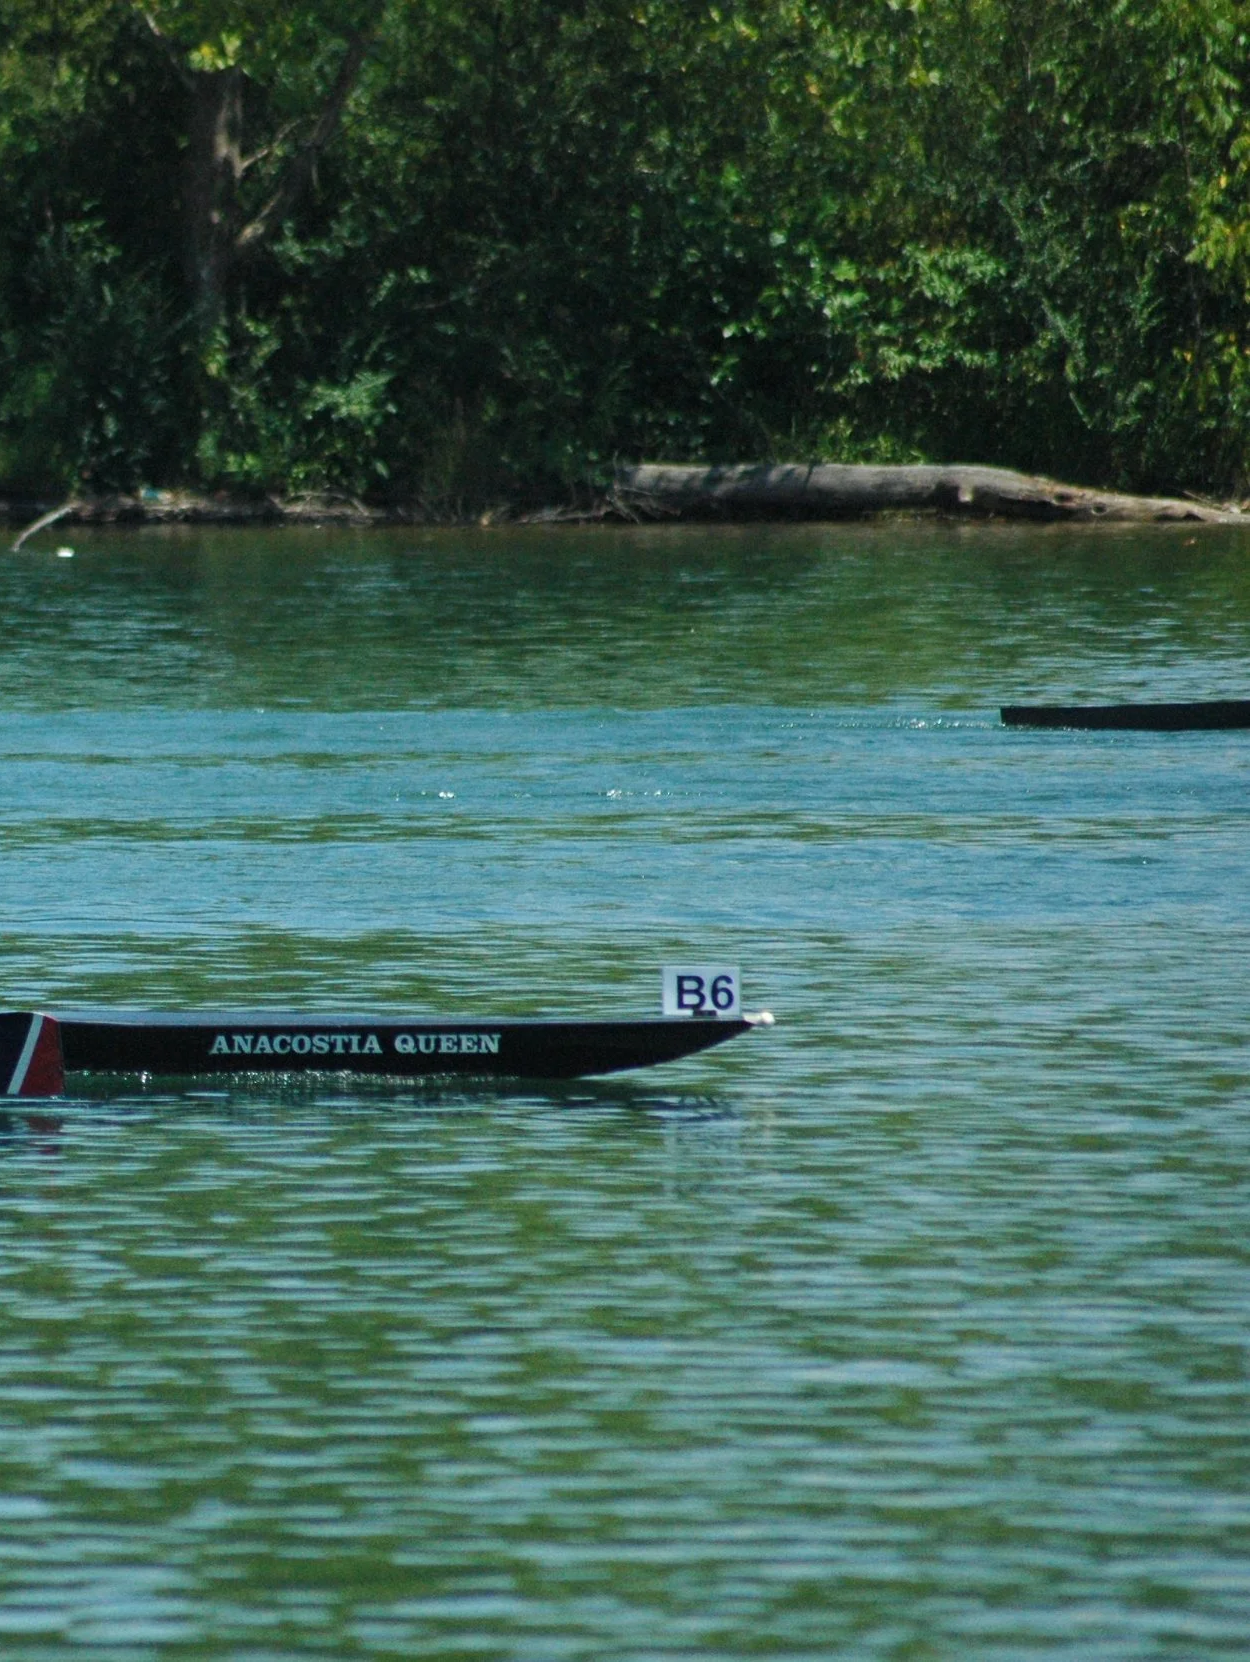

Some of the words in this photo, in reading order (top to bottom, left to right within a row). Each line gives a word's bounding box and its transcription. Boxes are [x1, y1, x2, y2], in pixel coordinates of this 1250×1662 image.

[676, 975, 734, 1010] B6
[209, 1033, 383, 1055] ANACOSTIA
[395, 1033, 502, 1055] QUEEN
